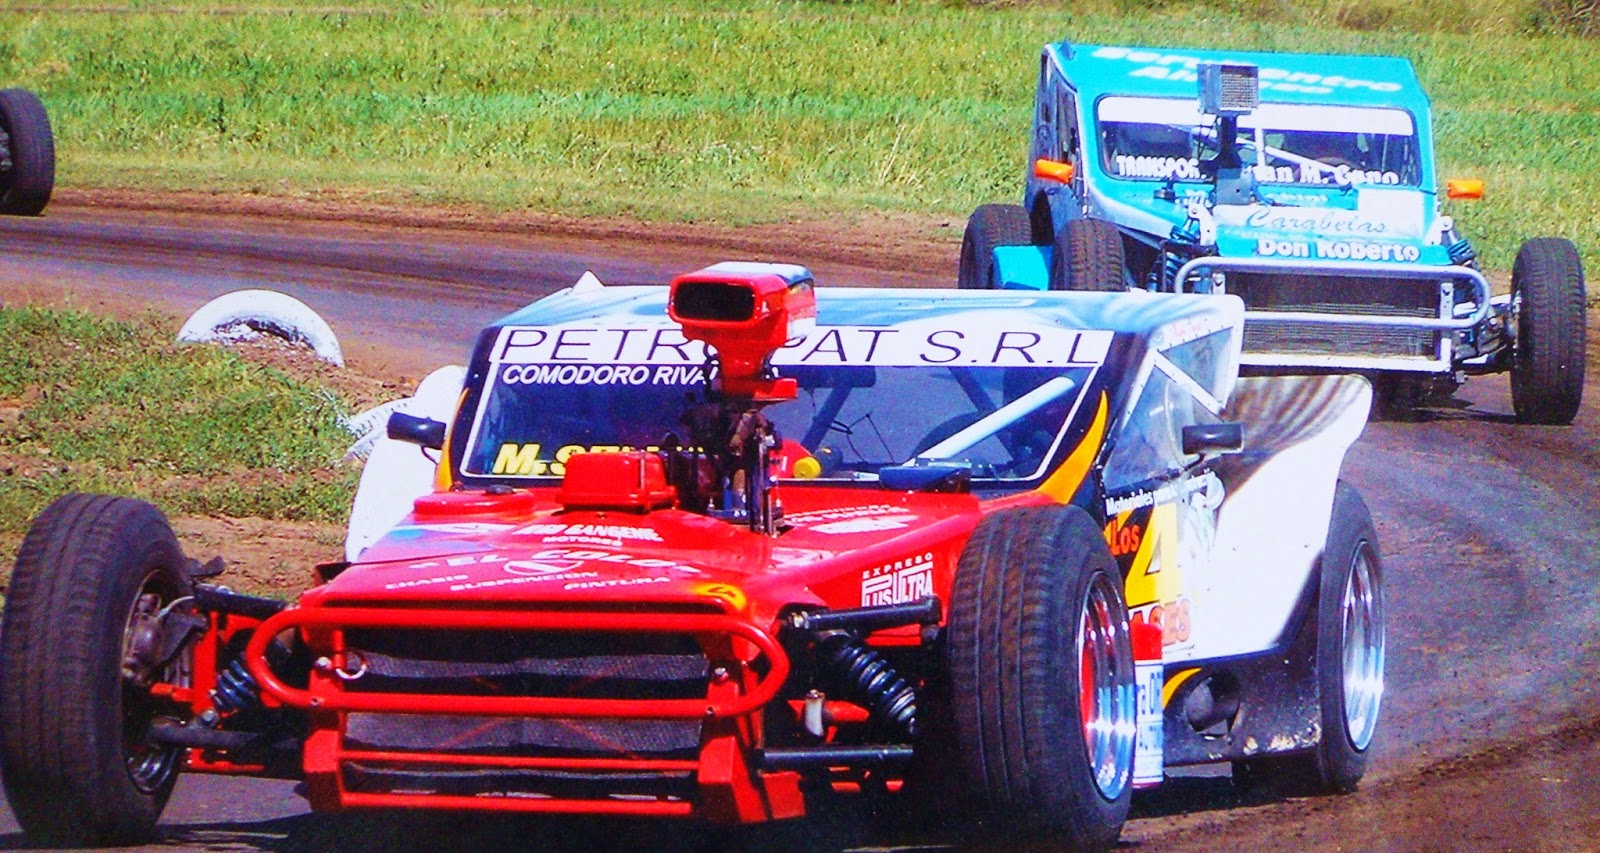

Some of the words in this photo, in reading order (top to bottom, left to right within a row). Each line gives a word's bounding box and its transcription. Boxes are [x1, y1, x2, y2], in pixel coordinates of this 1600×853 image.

[1116, 155, 1206, 180] TRANSPOR
[1258, 239, 1309, 258] Don
[1316, 240, 1420, 262] Roberto
[502, 364, 649, 386] COMODORO
[542, 535, 623, 547] MOTORES
[1124, 501, 1183, 608] 4
[862, 552, 933, 580] EXPRESO
[385, 574, 469, 590] CHASIS
[563, 576, 671, 590] PINTURA
